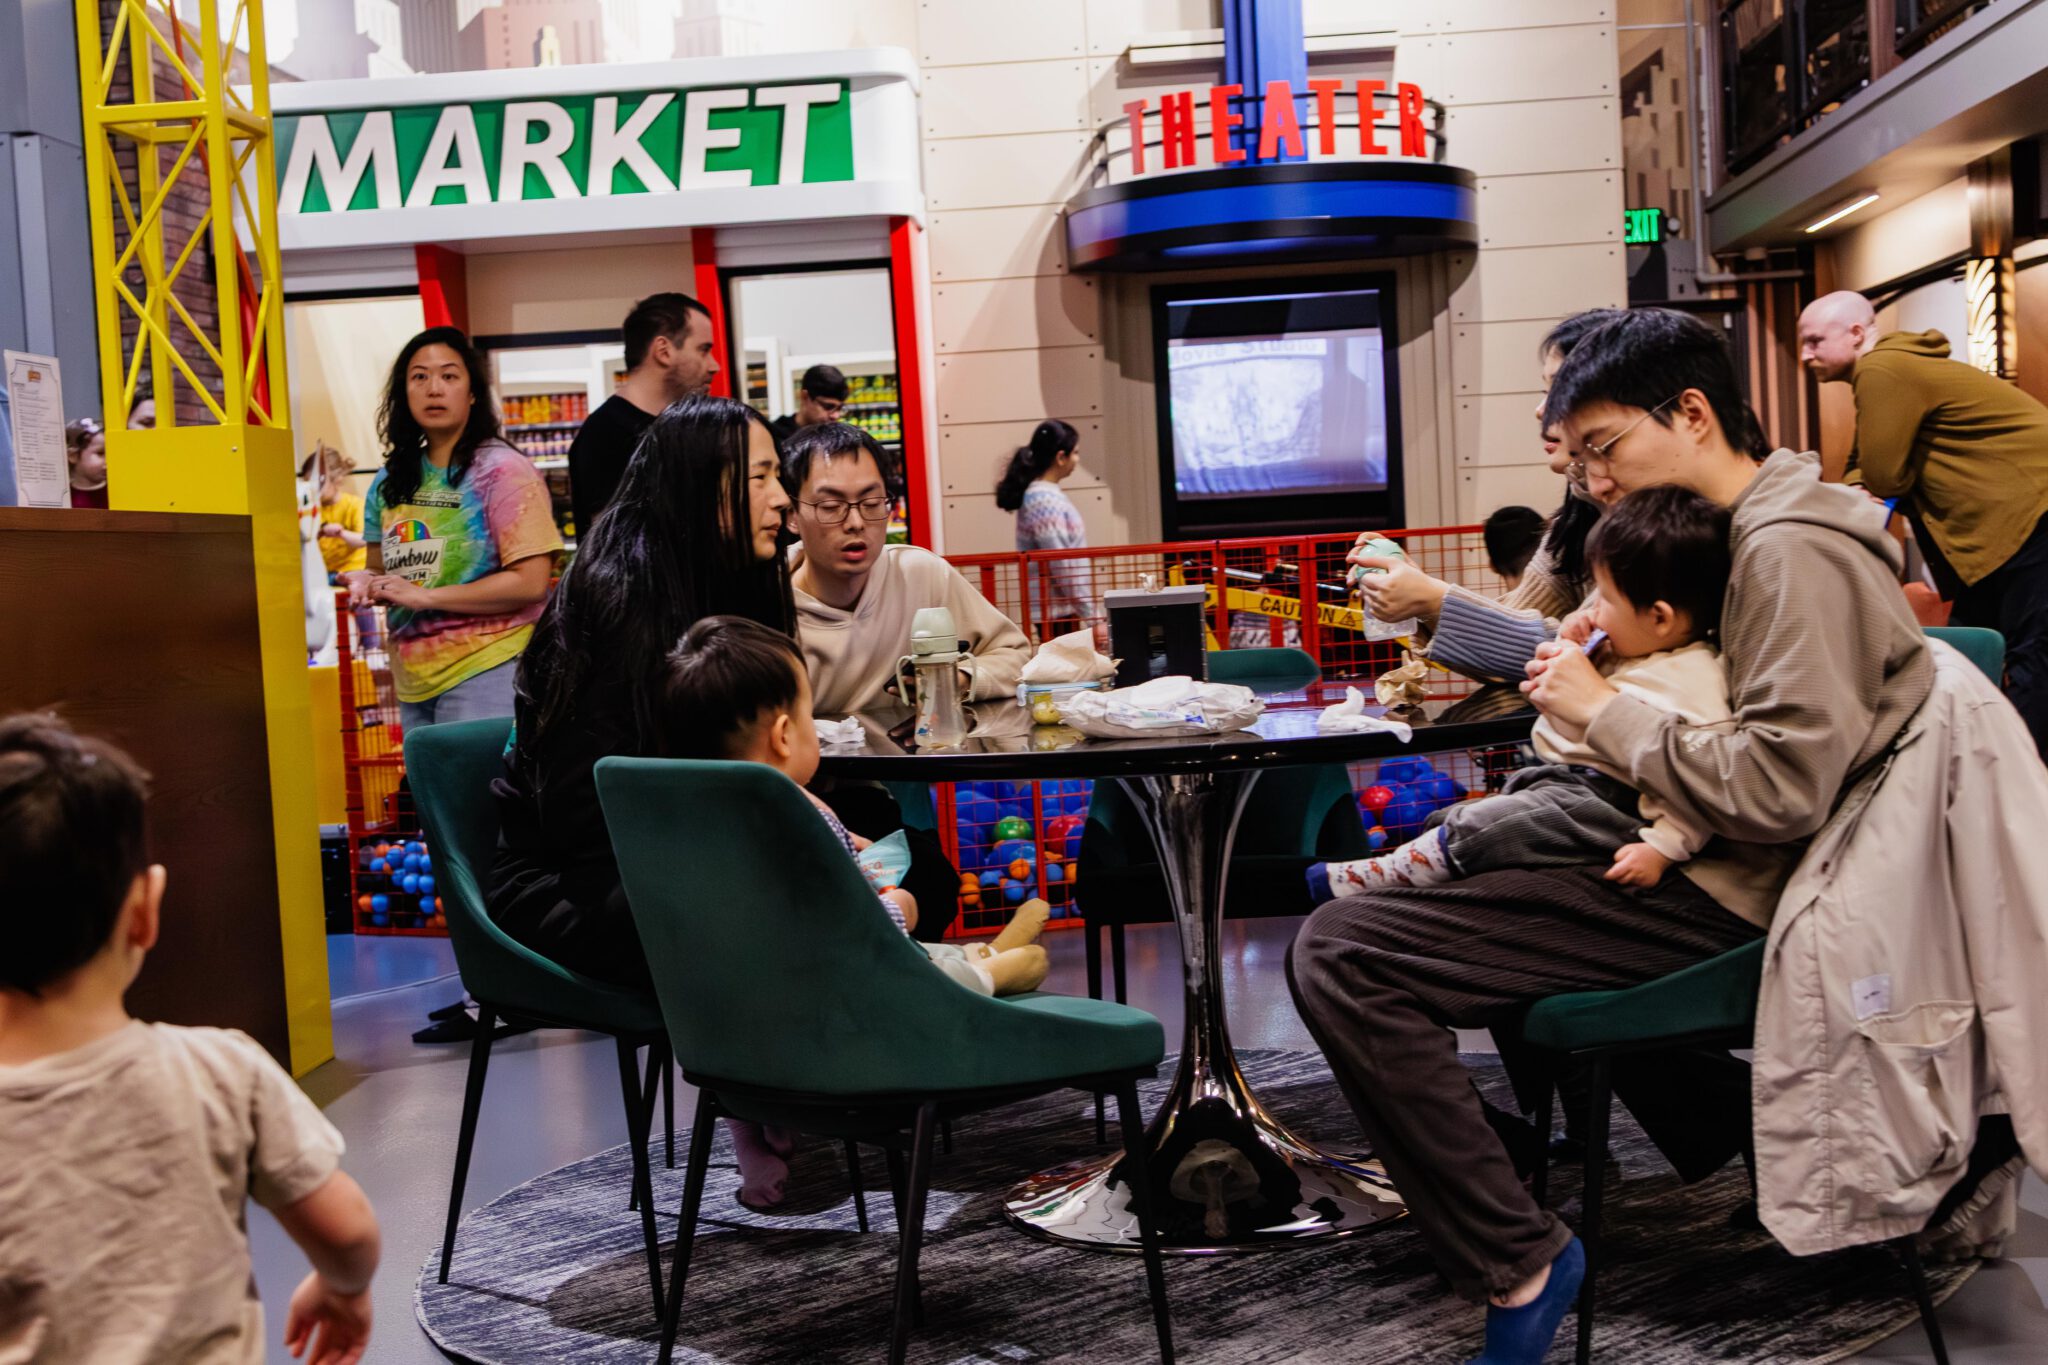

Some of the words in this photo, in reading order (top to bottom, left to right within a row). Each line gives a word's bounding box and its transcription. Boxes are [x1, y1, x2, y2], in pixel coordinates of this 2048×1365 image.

[277, 82, 842, 214] MARKET
[1123, 80, 1427, 175] THEATER
[384, 548, 438, 571] ainbow
[1260, 597, 1336, 624] CAUTN
